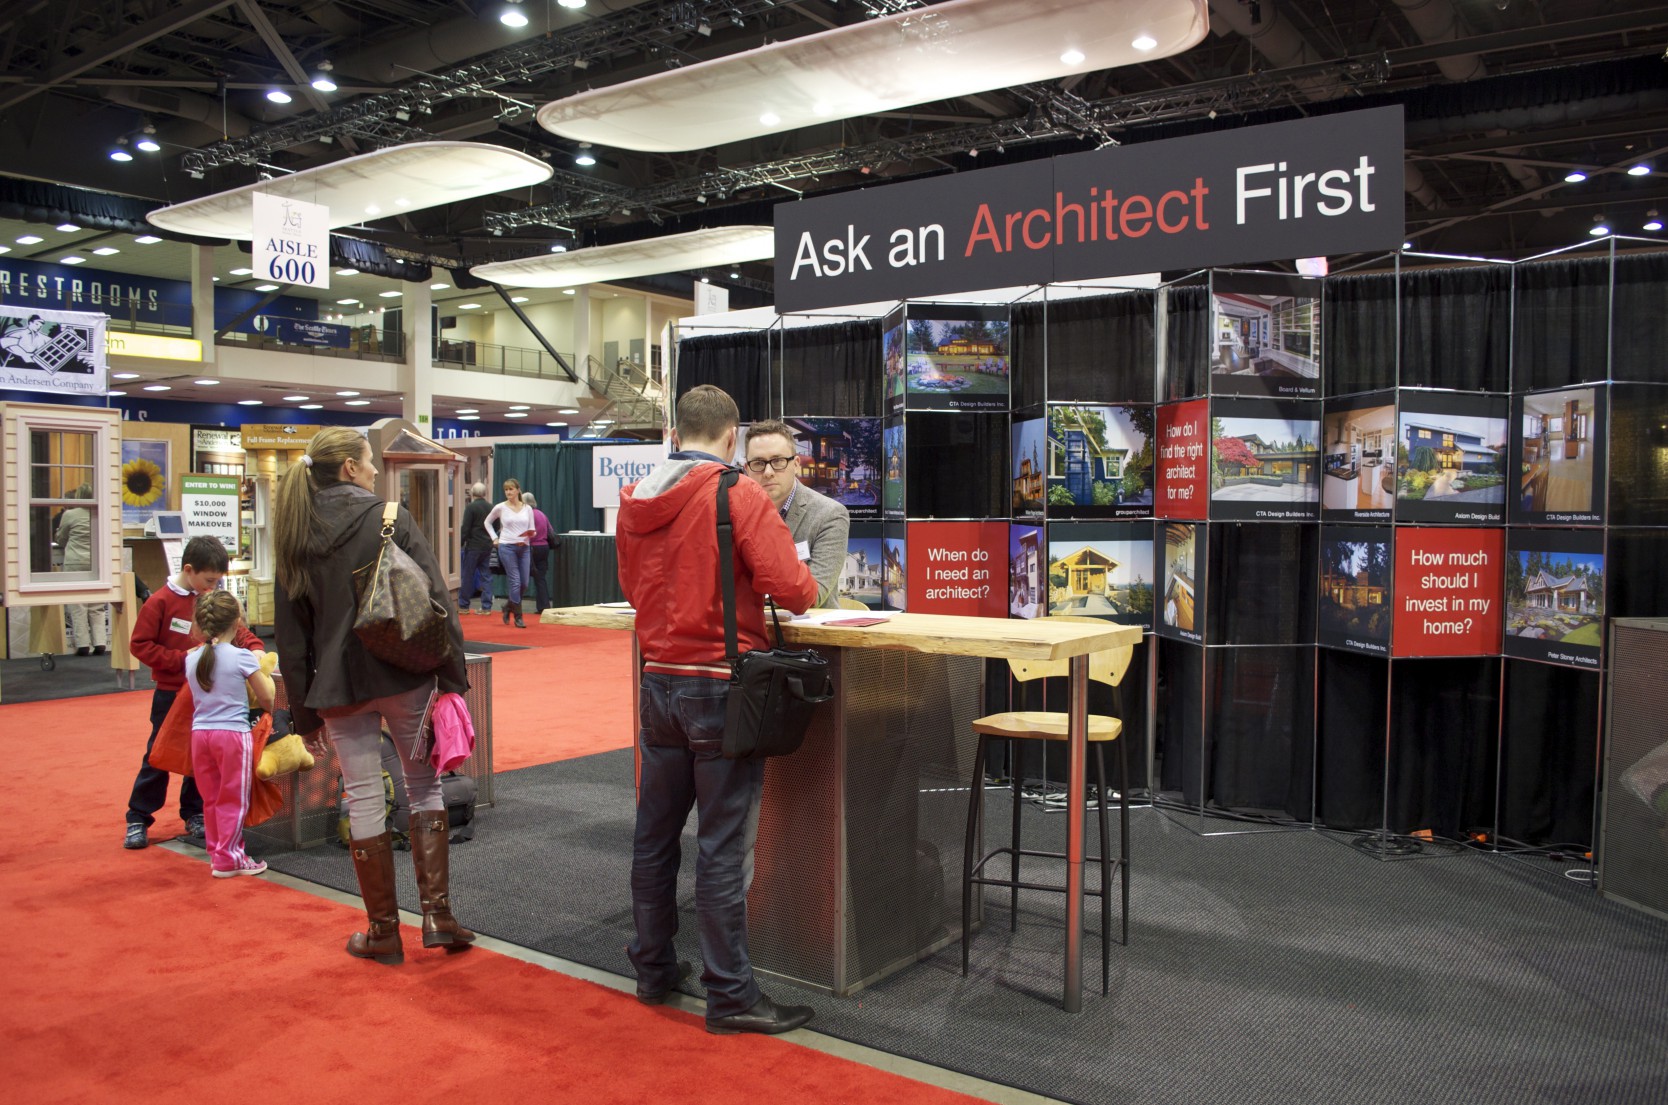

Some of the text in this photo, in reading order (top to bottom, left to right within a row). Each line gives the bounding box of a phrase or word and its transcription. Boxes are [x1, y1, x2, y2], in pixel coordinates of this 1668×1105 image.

[790, 156, 1375, 280] Ask an Architect First
[266, 237, 318, 258] AISLE
[269, 255, 316, 284] 600
[0, 270, 158, 311] RESTROOMS
[9, 375, 52, 387] Andersen
[52, 378, 94, 391] Company
[1166, 421, 1198, 438] How do I
[277, 437, 313, 445] Replacemen
[1160, 442, 1204, 460] find the right
[599, 457, 656, 477] Better
[1166, 464, 1196, 479] architect
[219, 482, 236, 490] WIN!
[1167, 484, 1194, 500] for me?
[1556, 514, 1572, 522] Design
[928, 547, 989, 562] When do
[1411, 549, 1488, 566] How much
[926, 566, 989, 580] I need an
[1421, 572, 1478, 589] should I
[926, 585, 990, 599] architect?
[1405, 595, 1491, 615] invest in my
[1423, 618, 1473, 635] home?
[1547, 651, 1559, 659] Peter
[1575, 656, 1598, 664] Architects
